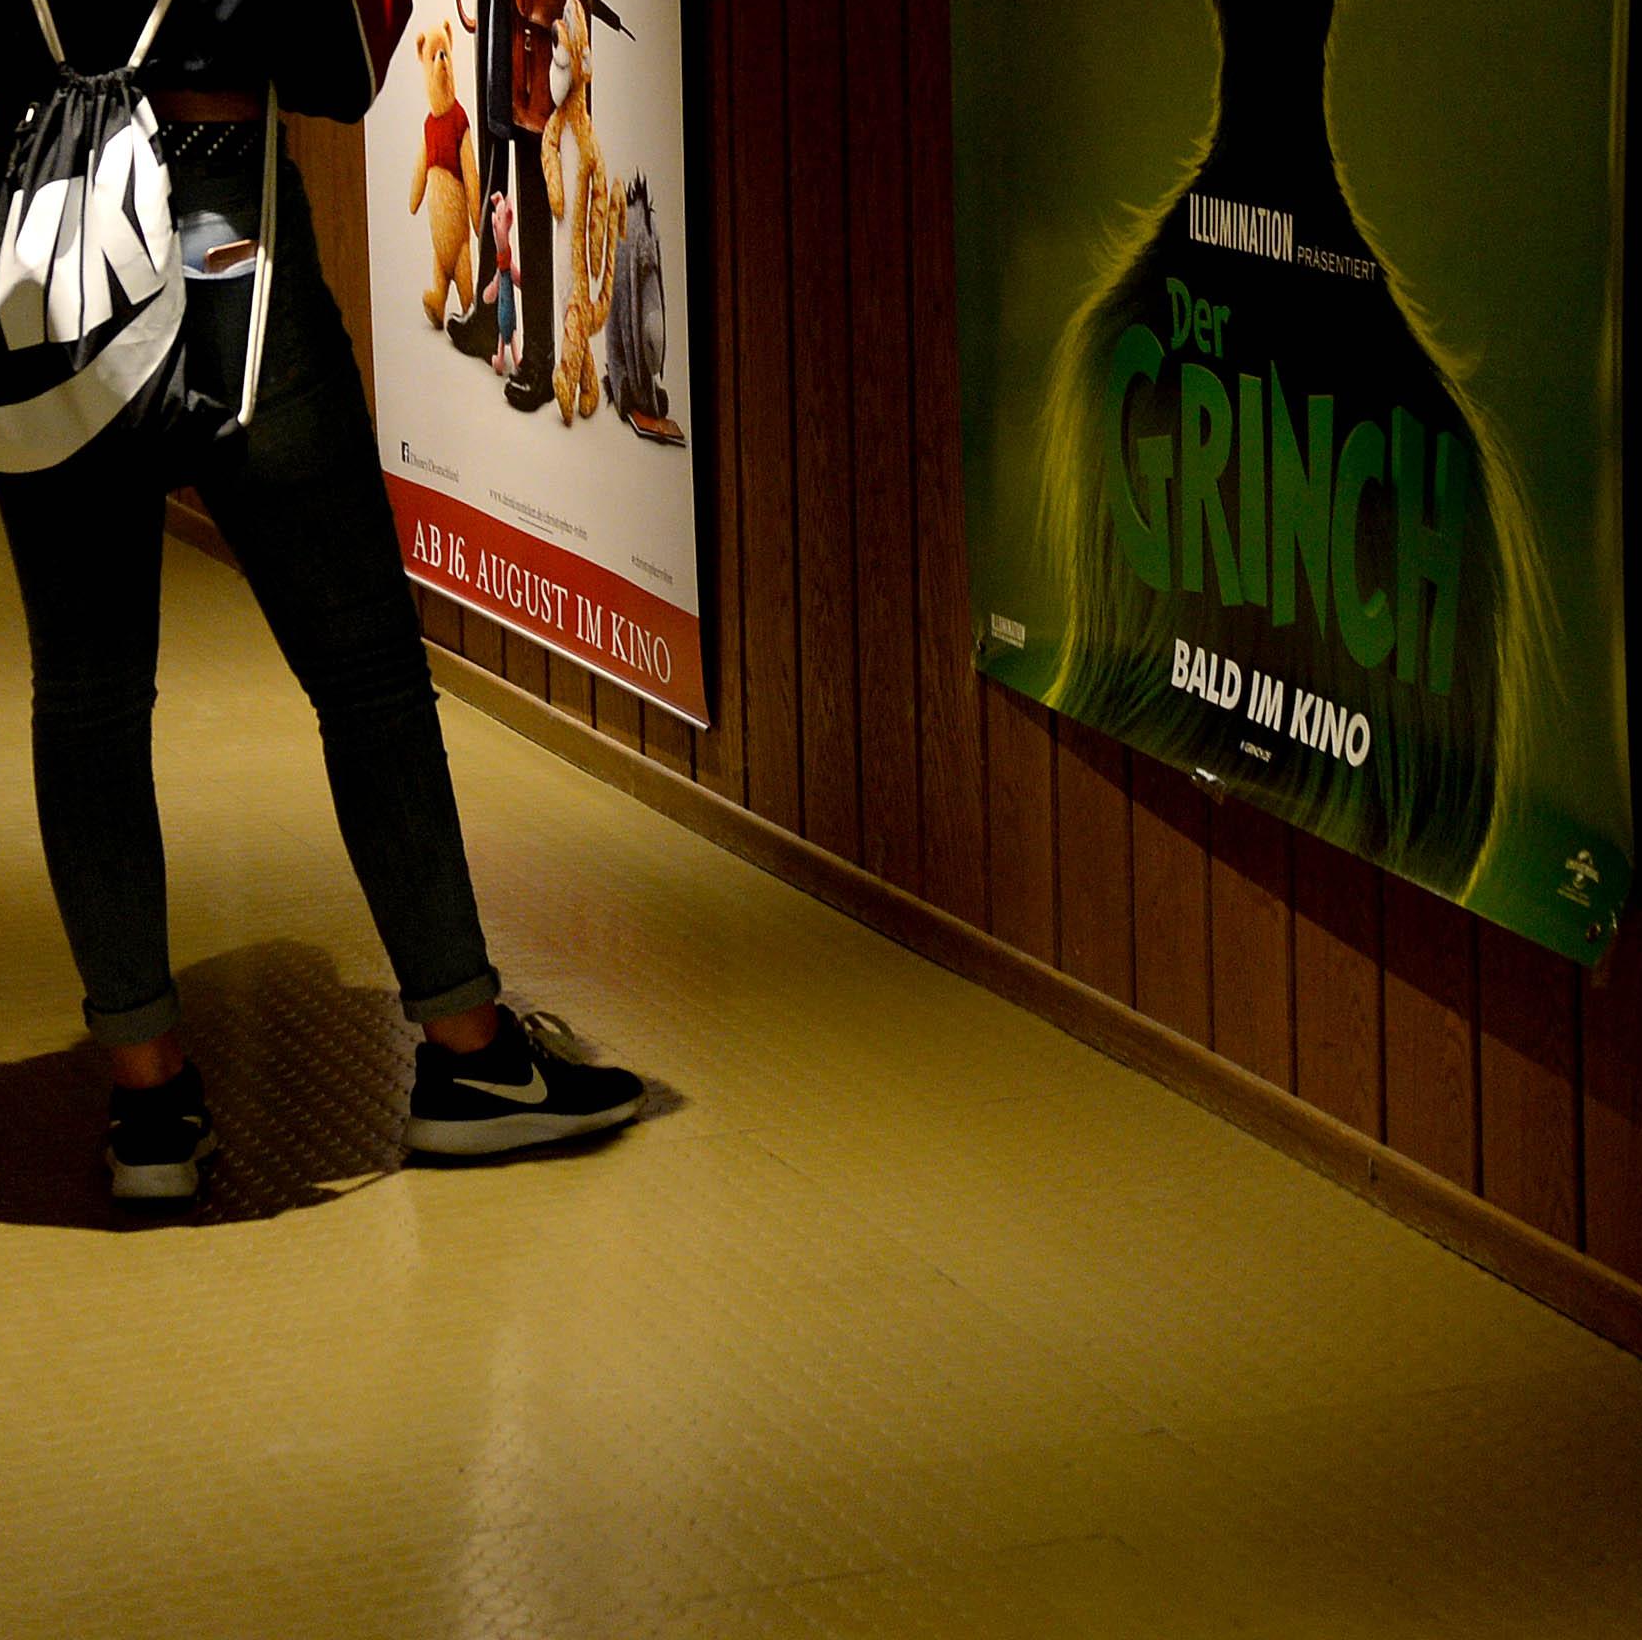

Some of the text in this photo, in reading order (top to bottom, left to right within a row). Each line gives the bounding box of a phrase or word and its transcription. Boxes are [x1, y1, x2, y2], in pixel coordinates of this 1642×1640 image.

[1189, 192, 1376, 281] ILLUMINATION PRÄSENTIERT
[1165, 275, 1233, 359] Der
[1103, 323, 1465, 695] GRINCH
[413, 520, 442, 568] AB
[448, 535, 470, 584] 16.
[476, 549, 568, 631] AUGUST
[575, 594, 603, 651] IM
[611, 610, 671, 684] KINO
[1171, 637, 1371, 768] BALD IM KINO
